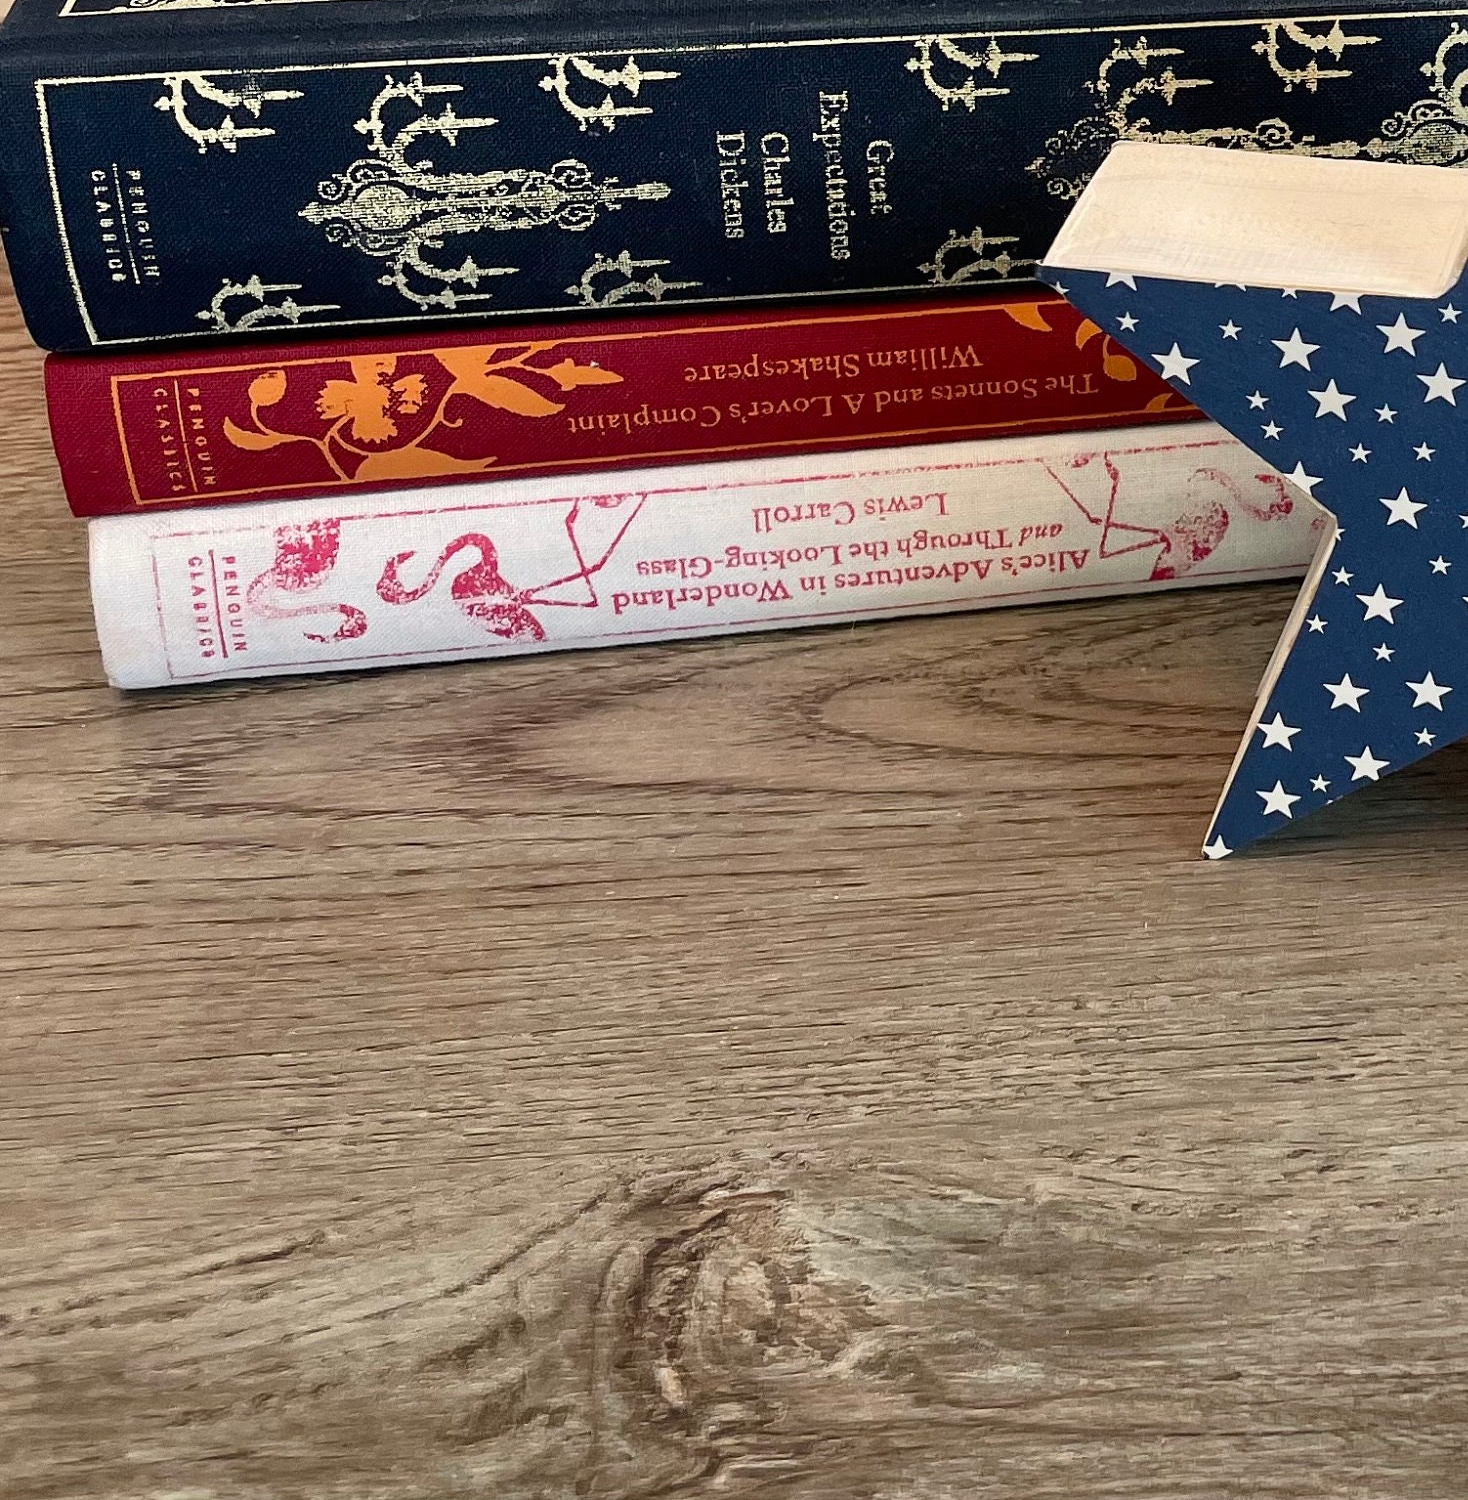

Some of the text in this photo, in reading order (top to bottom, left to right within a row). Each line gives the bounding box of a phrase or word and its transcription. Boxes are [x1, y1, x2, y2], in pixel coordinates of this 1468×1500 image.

[126, 170, 160, 276] PENGUIN
[716, 130, 749, 238] Dickens
[761, 132, 795, 233] Charles
[812, 91, 856, 260] Expectations
[866, 139, 895, 215] Great
[567, 373, 1099, 436] The Sonnets and A Lover's Complaint
[684, 344, 984, 382] William Shakespeare
[187, 388, 216, 485] PENGUIN
[637, 523, 1063, 579] and Through the Looking-Glass
[752, 492, 949, 534] Lewis Carroll
[188, 556, 215, 657] CLASSICS
[222, 556, 248, 651] PENGUIN
[611, 549, 1091, 615] Alice's Adventures in Wonderland
